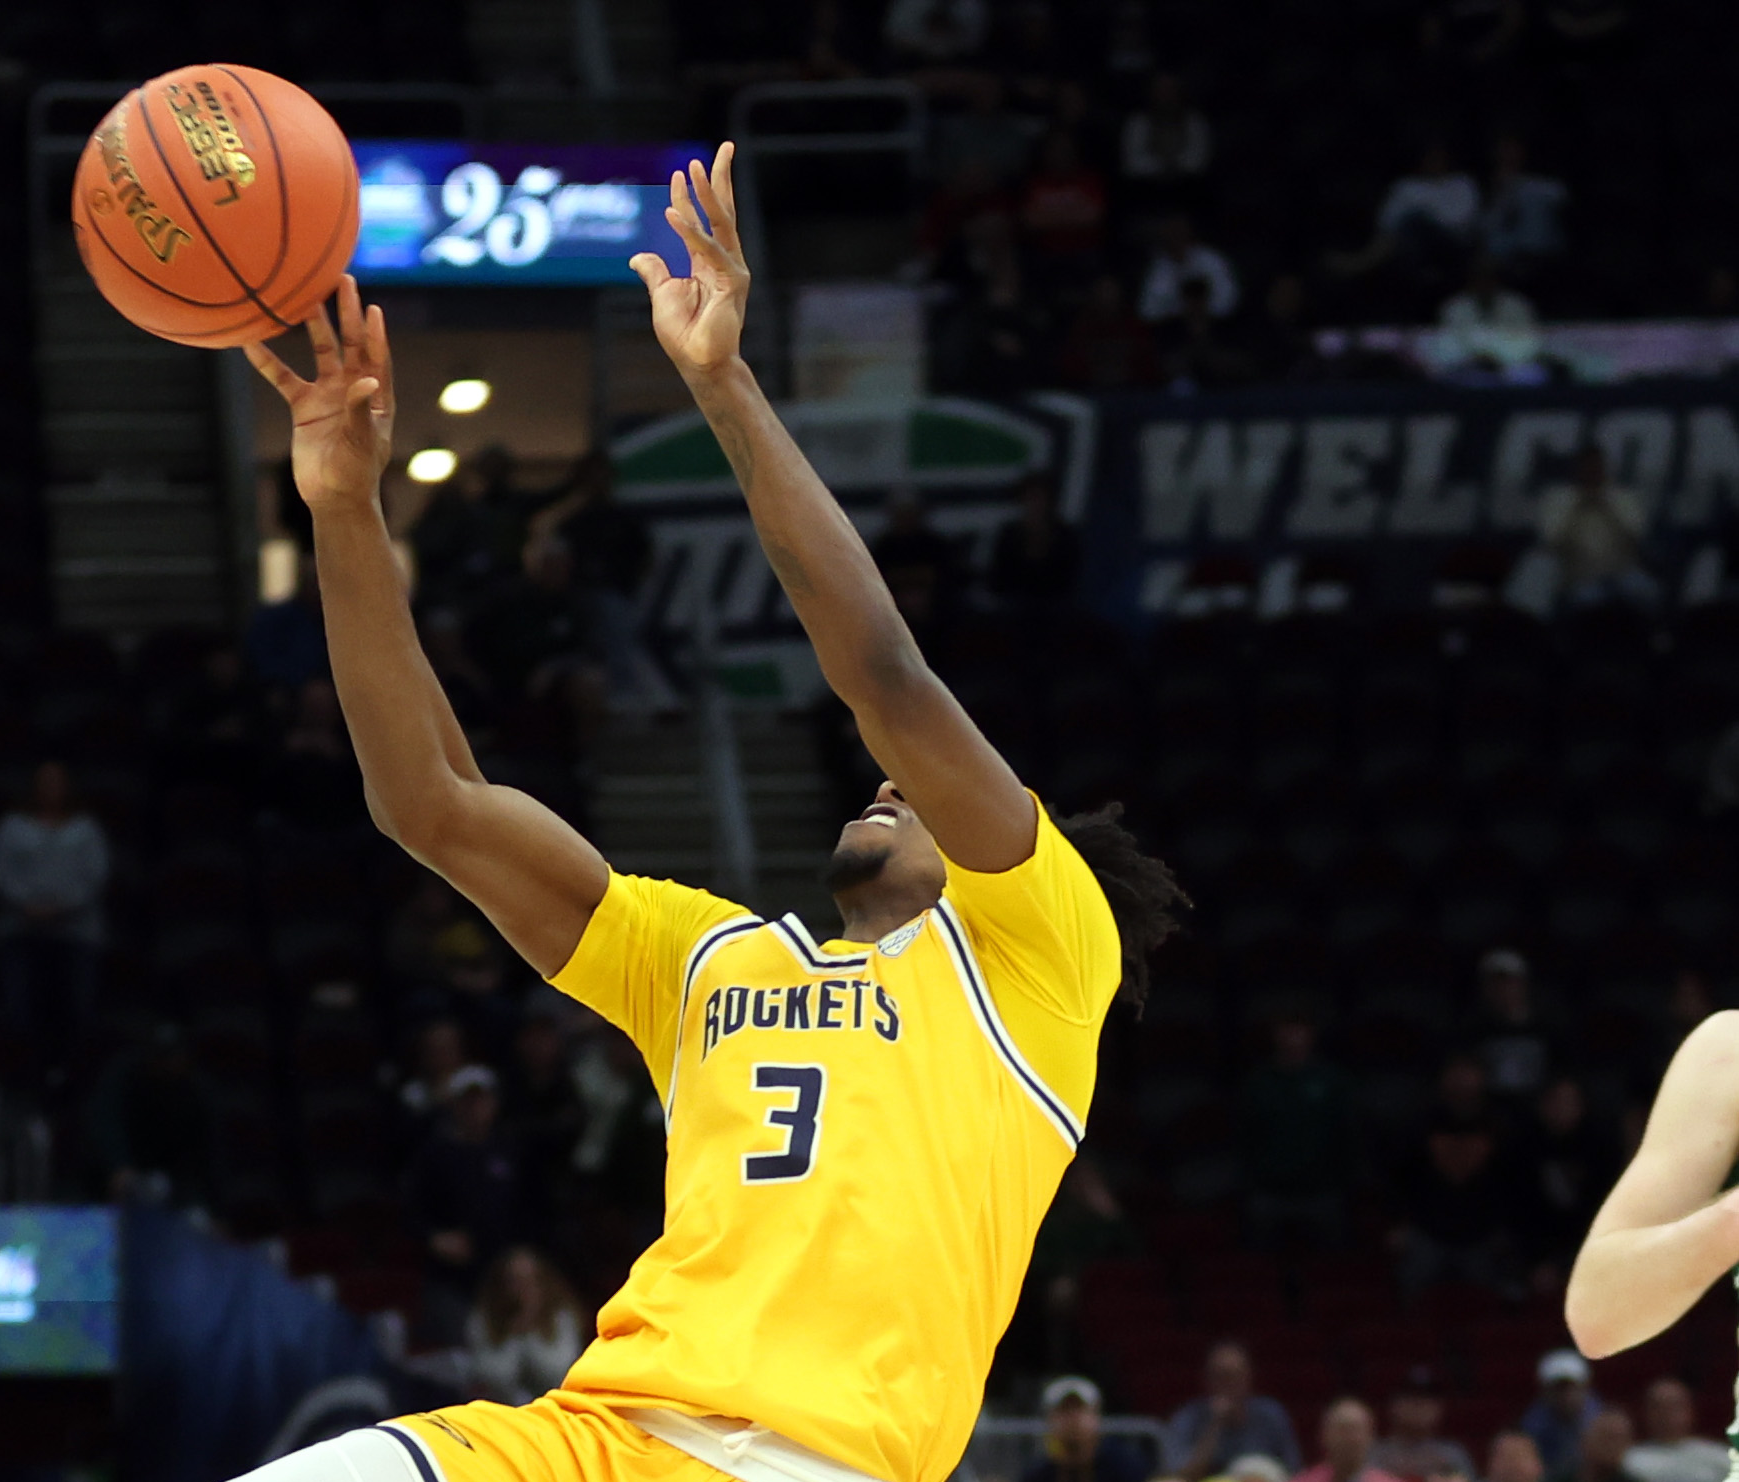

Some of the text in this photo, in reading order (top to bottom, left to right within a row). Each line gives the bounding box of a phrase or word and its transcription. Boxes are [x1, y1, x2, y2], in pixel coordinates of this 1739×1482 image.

[421, 161, 561, 267] 25
[701, 979, 901, 1063] ROCKETS
[742, 1063, 828, 1186] 3
